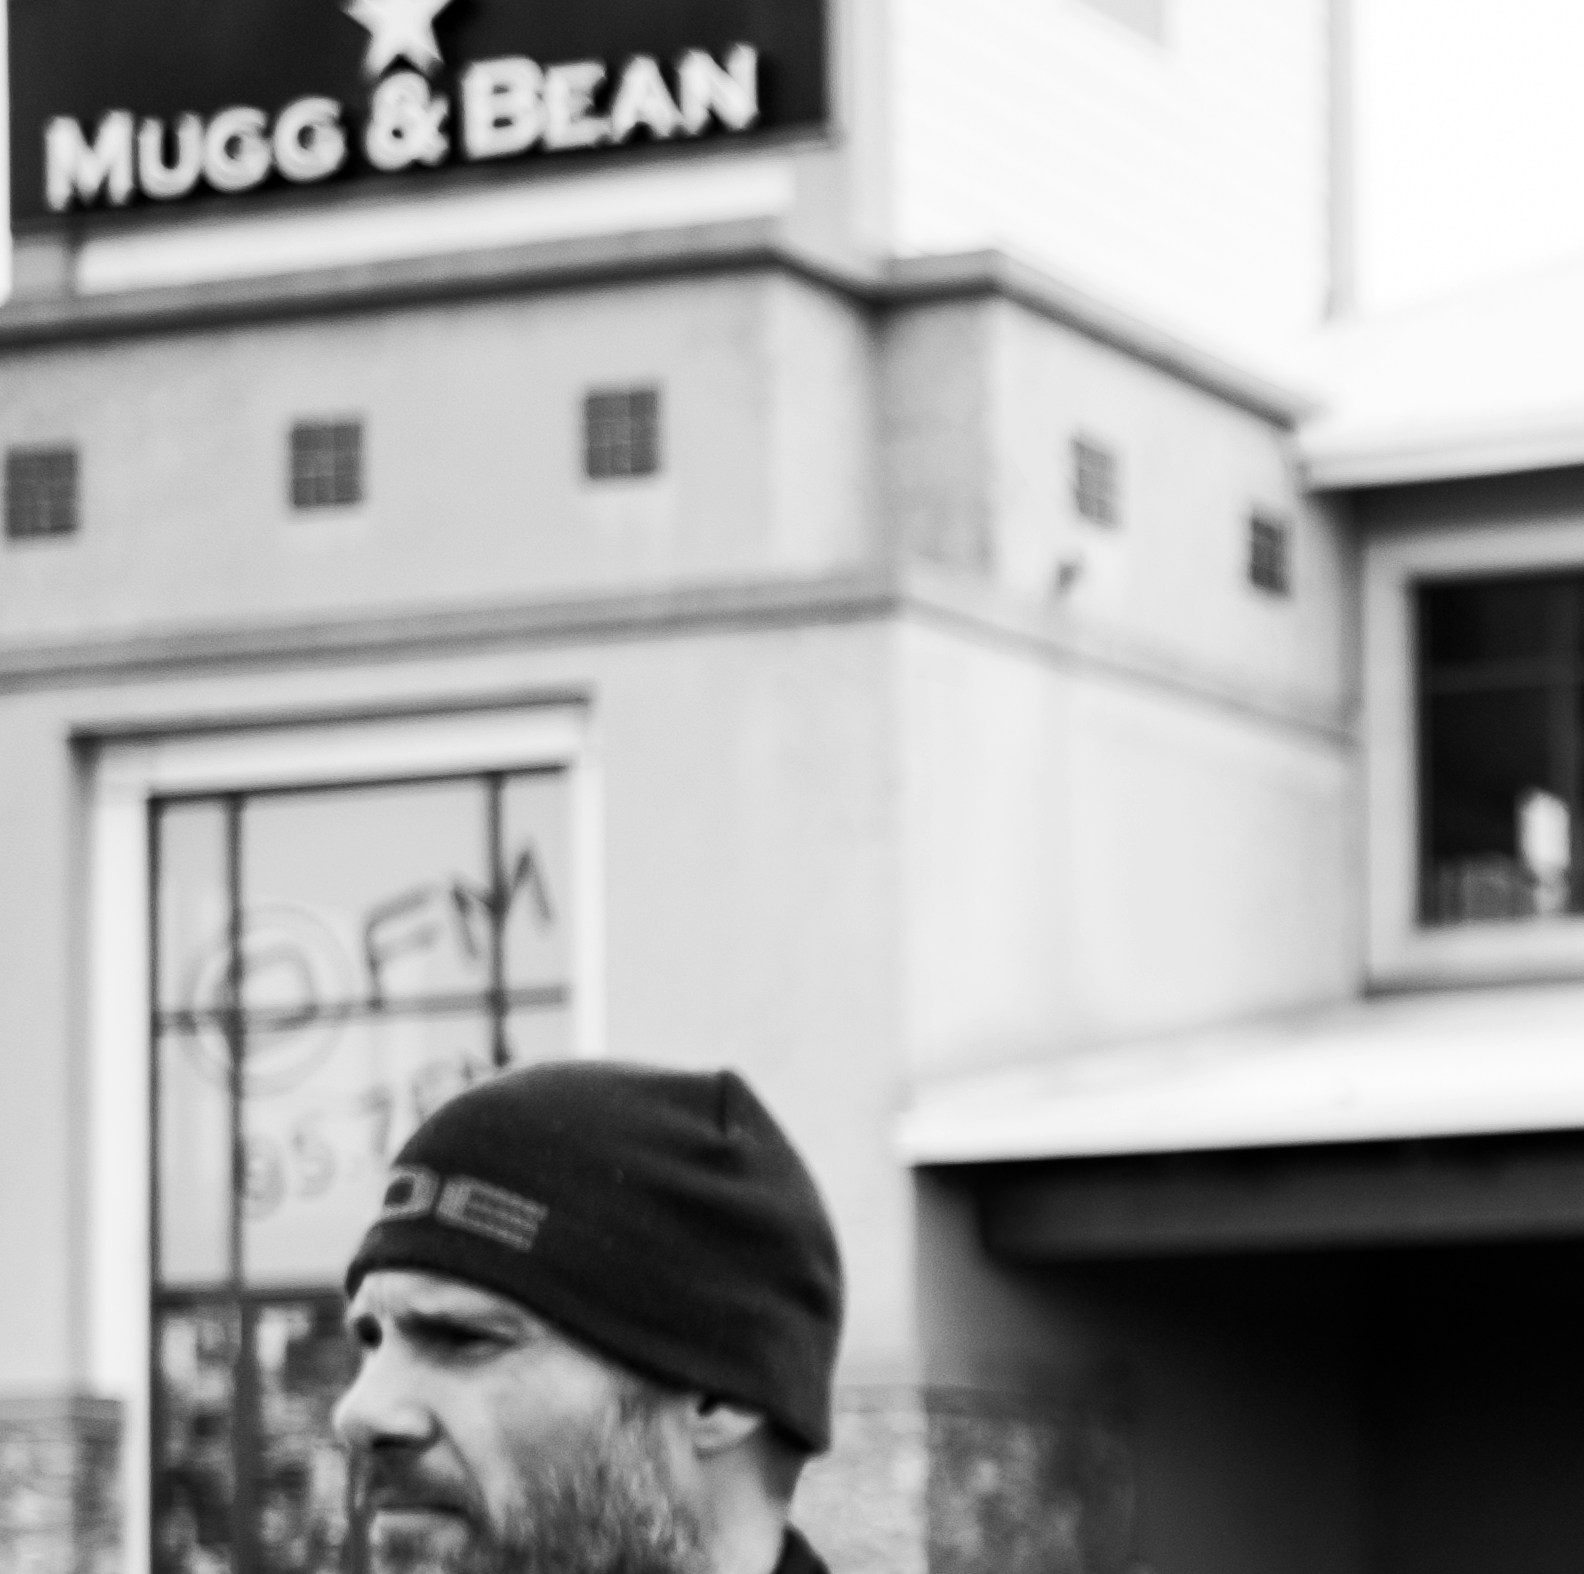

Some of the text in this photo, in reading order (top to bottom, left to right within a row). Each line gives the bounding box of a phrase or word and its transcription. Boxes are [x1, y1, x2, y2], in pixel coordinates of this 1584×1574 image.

[43, 42, 762, 212] MUGG & BEAN
